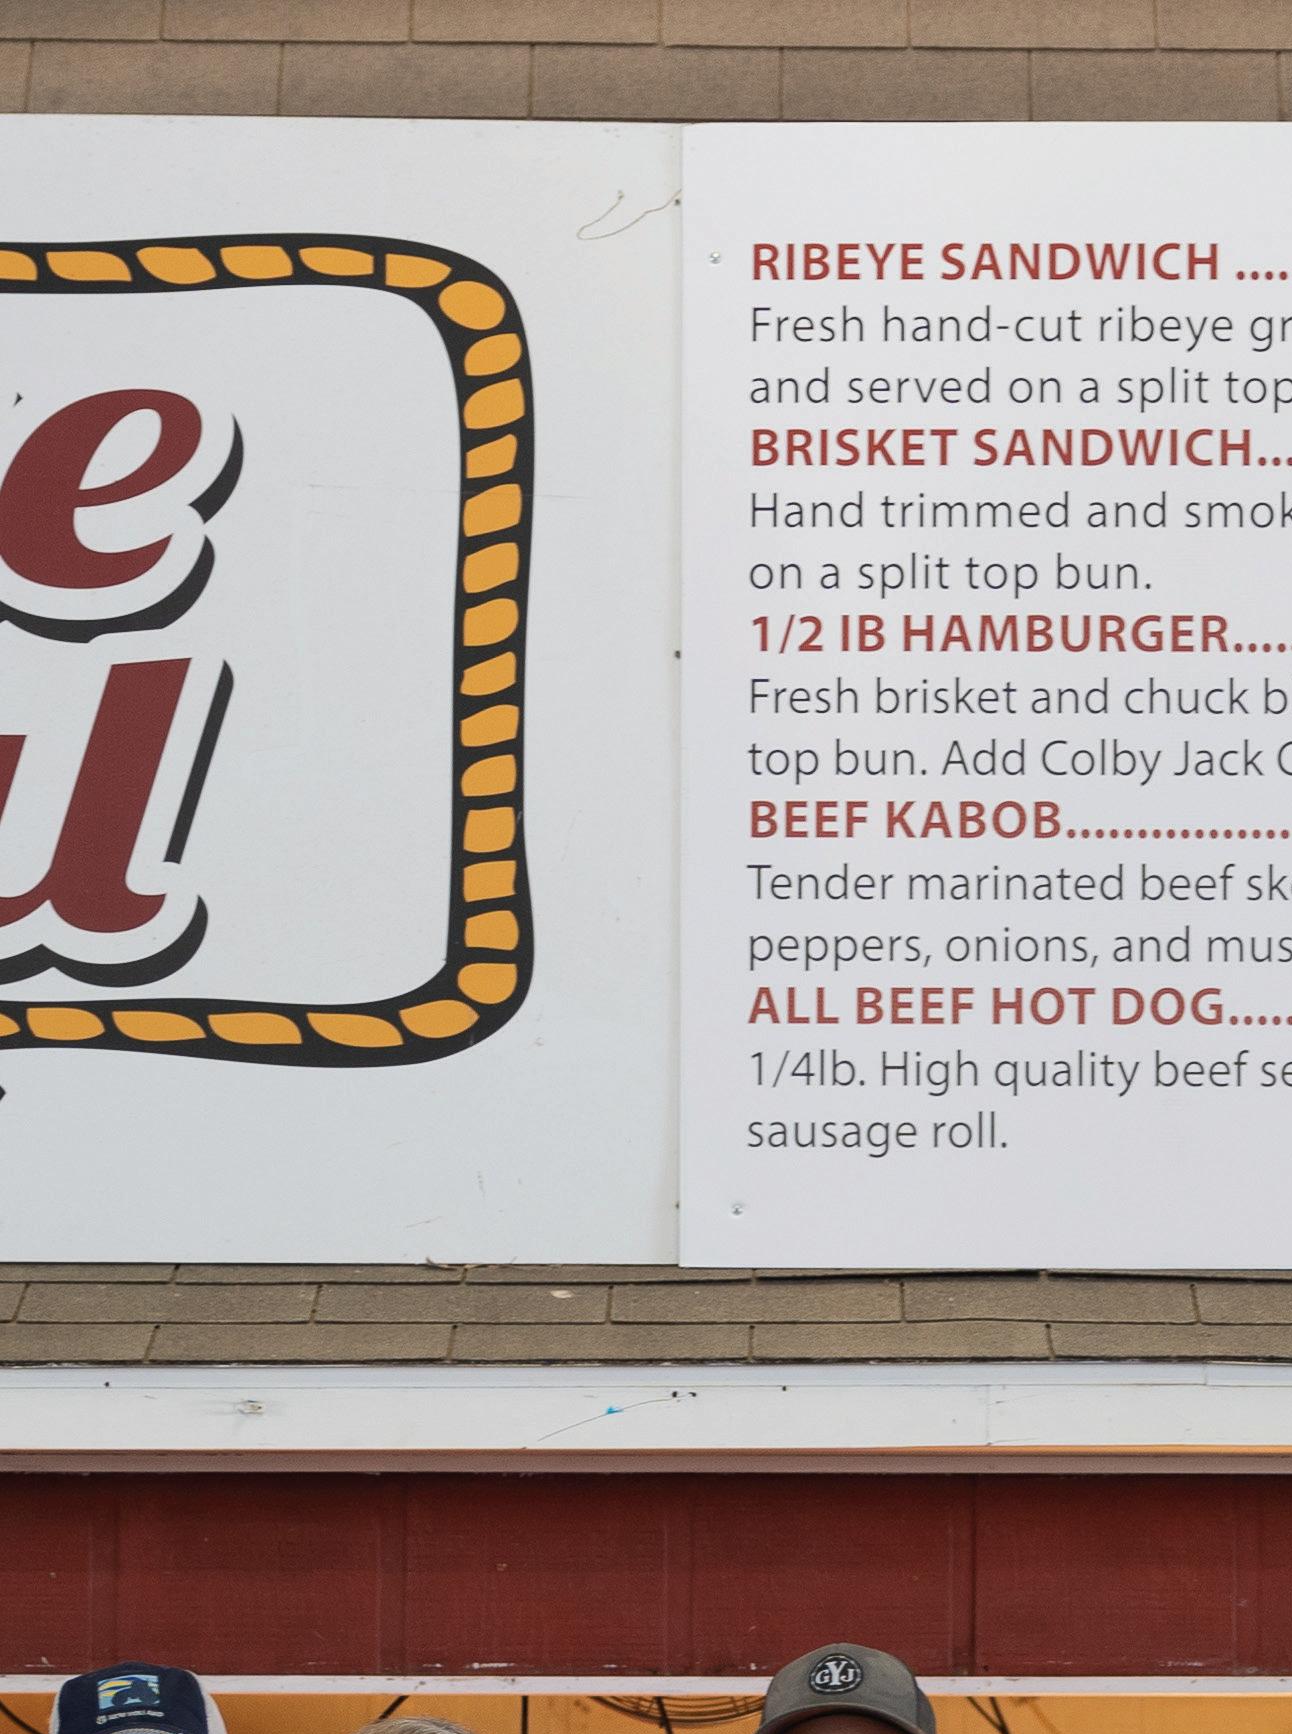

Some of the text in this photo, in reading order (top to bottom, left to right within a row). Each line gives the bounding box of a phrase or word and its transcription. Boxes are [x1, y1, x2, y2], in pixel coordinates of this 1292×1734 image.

[751, 241, 926, 281] RIBEYE
[939, 241, 1219, 281] SANDWICH
[751, 304, 865, 343] Fresh
[882, 304, 1083, 343] hand-cut
[1099, 304, 1234, 353] ribeye
[749, 365, 830, 405] and
[847, 365, 992, 405] served
[1008, 376, 1062, 404] on
[1078, 377, 1100, 404] a
[1116, 365, 1211, 414] split
[751, 427, 960, 467] BRISKET
[972, 427, 1252, 467] SANDWICH
[750, 490, 864, 529] Hand
[879, 490, 1070, 529] trimmed
[1086, 490, 1167, 529] and
[748, 551, 1152, 600] on a split top bun.
[751, 613, 825, 655] 1/2
[840, 613, 887, 653] IB
[902, 613, 1230, 653] HAMBURGER
[749, 675, 859, 715] Fresh
[875, 676, 1018, 715] brisket
[1030, 676, 1109, 715] and
[1123, 676, 1251, 715] chuck
[746, 742, 820, 786] top
[834, 737, 928, 776] bun.
[940, 737, 1026, 777] Add
[1040, 738, 1163, 787] Colby
[1173, 738, 1265, 777] Jack
[749, 799, 870, 839] BEEF
[885, 800, 1062, 840] KABOB
[745, 862, 895, 901] Tender
[908, 862, 1124, 901] marinated
[1140, 862, 1237, 902] beef
[748, 934, 933, 972] peppers,
[945, 926, 1099, 969] onions,
[1112, 924, 1191, 963] and
[747, 986, 841, 1025] ALL
[855, 986, 975, 1025] BEEF
[991, 986, 1097, 1026] HOT
[1111, 986, 1224, 1026] DOG
[750, 1048, 866, 1089] 1/4lb.
[881, 1048, 979, 1097] High
[993, 1049, 1141, 1098] quality
[1154, 1049, 1251, 1088] beef
[746, 1110, 1008, 1159] sausage roll.
